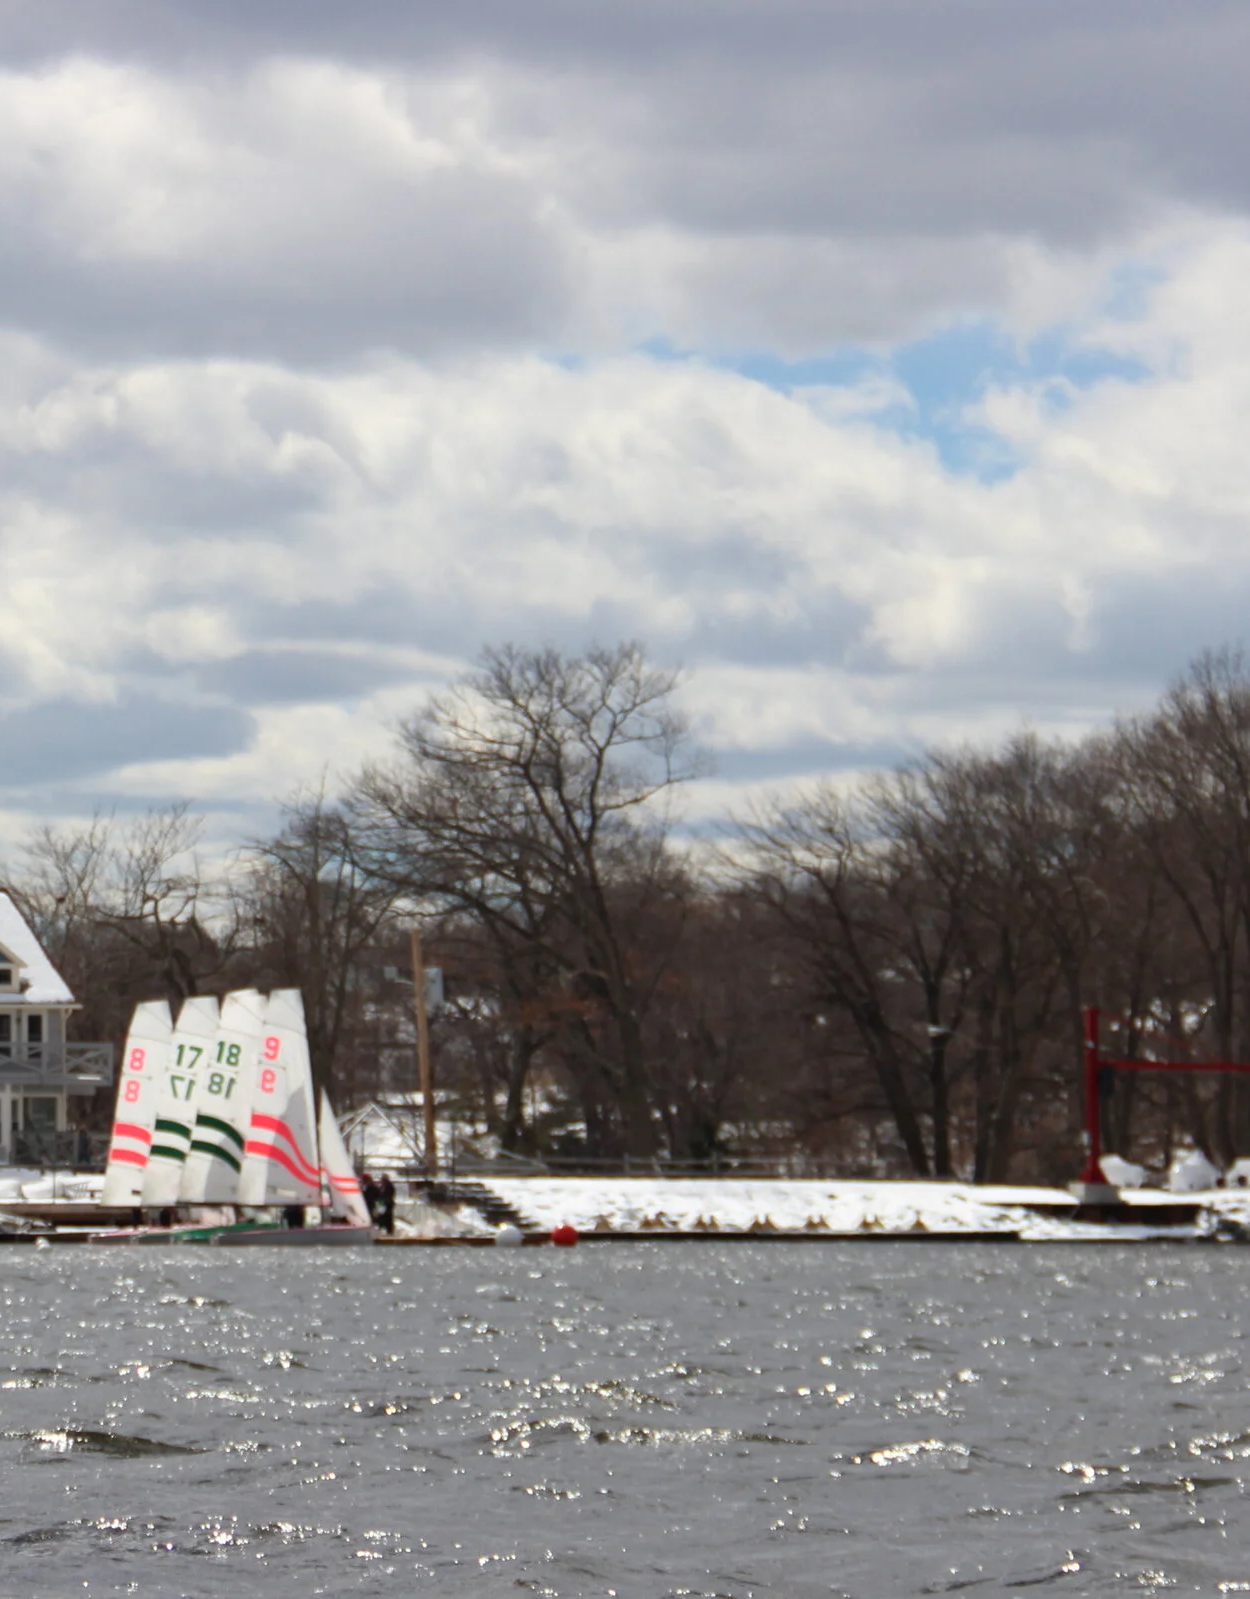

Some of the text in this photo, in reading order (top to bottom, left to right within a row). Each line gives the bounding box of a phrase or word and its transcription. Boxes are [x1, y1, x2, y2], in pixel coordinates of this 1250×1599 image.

[129, 1048, 146, 1072] 8
[176, 1043, 204, 1069] 17
[216, 1040, 241, 1067] 18
[263, 1035, 281, 1061] 9
